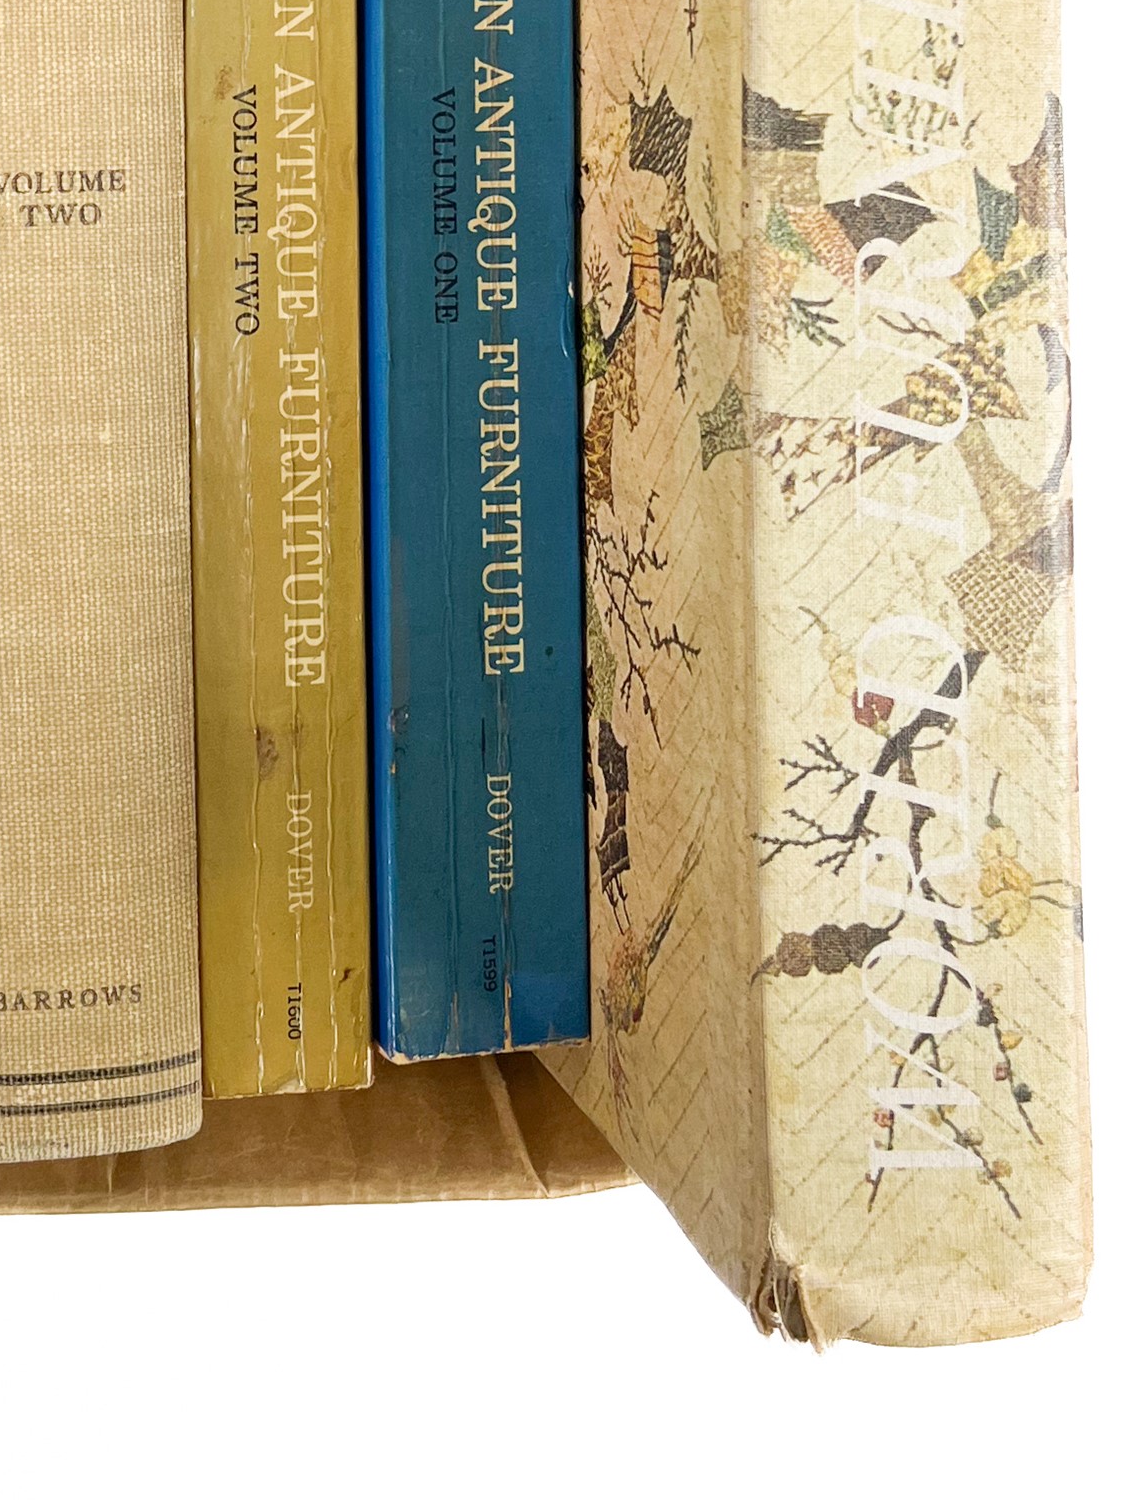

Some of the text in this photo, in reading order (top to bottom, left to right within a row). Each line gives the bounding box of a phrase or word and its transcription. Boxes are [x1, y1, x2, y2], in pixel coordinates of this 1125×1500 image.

[19, 203, 101, 227] TWO
[232, 84, 260, 337] VOLUME TWO
[267, 63, 318, 320] ANTIQUE
[431, 86, 459, 325] VOLUME ONE
[467, 57, 517, 311] ANTIQUE
[278, 348, 325, 687] FURNITURE
[478, 338, 525, 676] FURNITURE
[286, 790, 315, 913] DOVER
[486, 772, 514, 895] DOVER
[857, 614, 982, 1173] WORLD
[287, 982, 302, 1041] T1600
[481, 935, 497, 993] T1599
